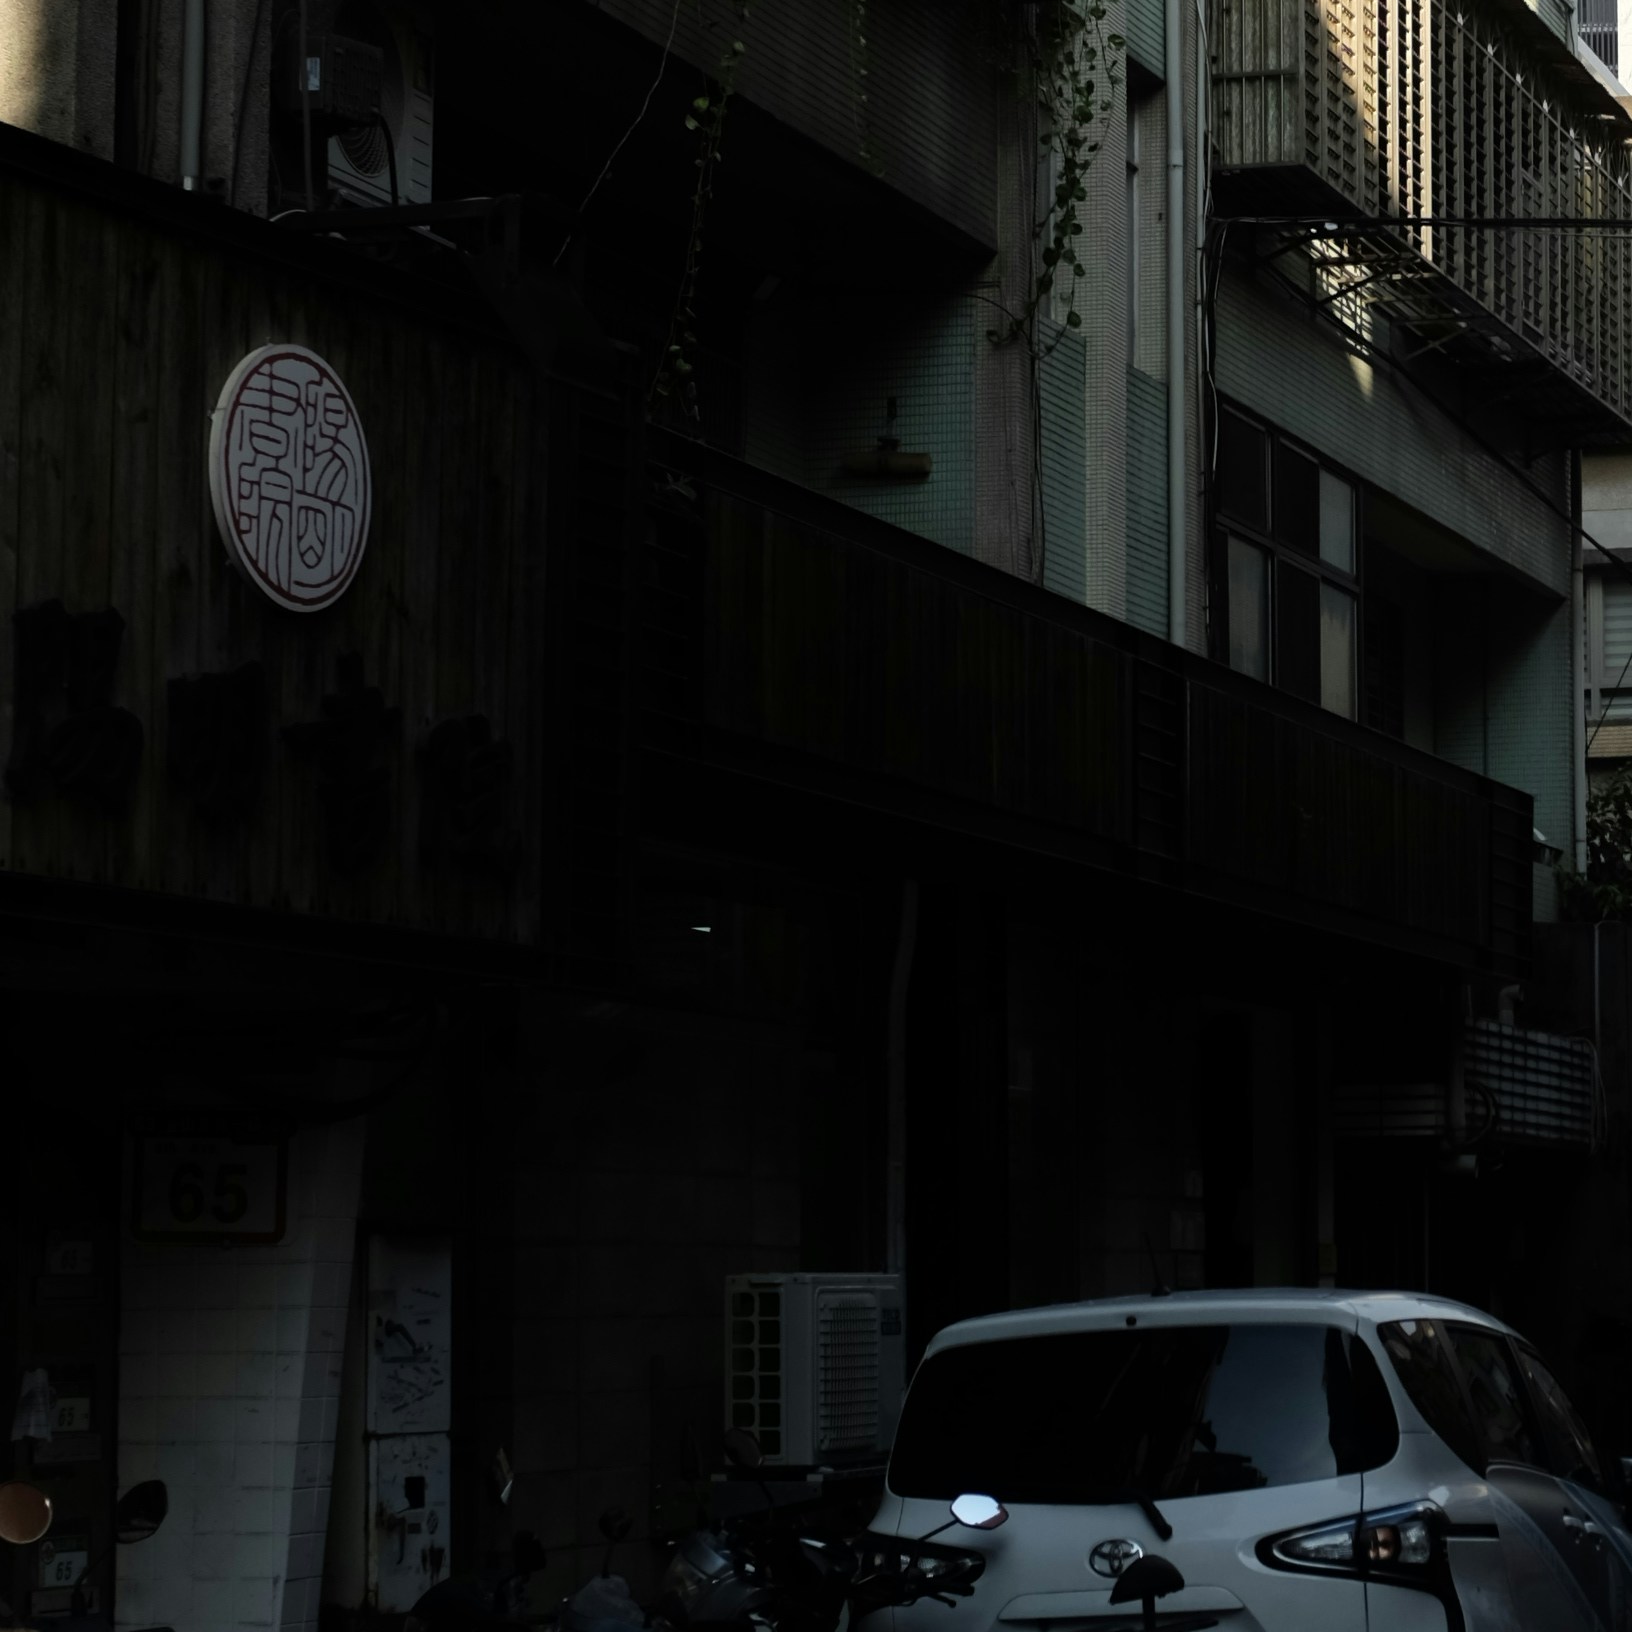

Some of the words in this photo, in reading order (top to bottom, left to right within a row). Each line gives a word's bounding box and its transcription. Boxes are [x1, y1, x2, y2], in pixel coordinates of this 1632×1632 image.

[168, 1161, 248, 1224] 65
[58, 1406, 76, 1427] 65
[55, 1560, 73, 1582] 65
